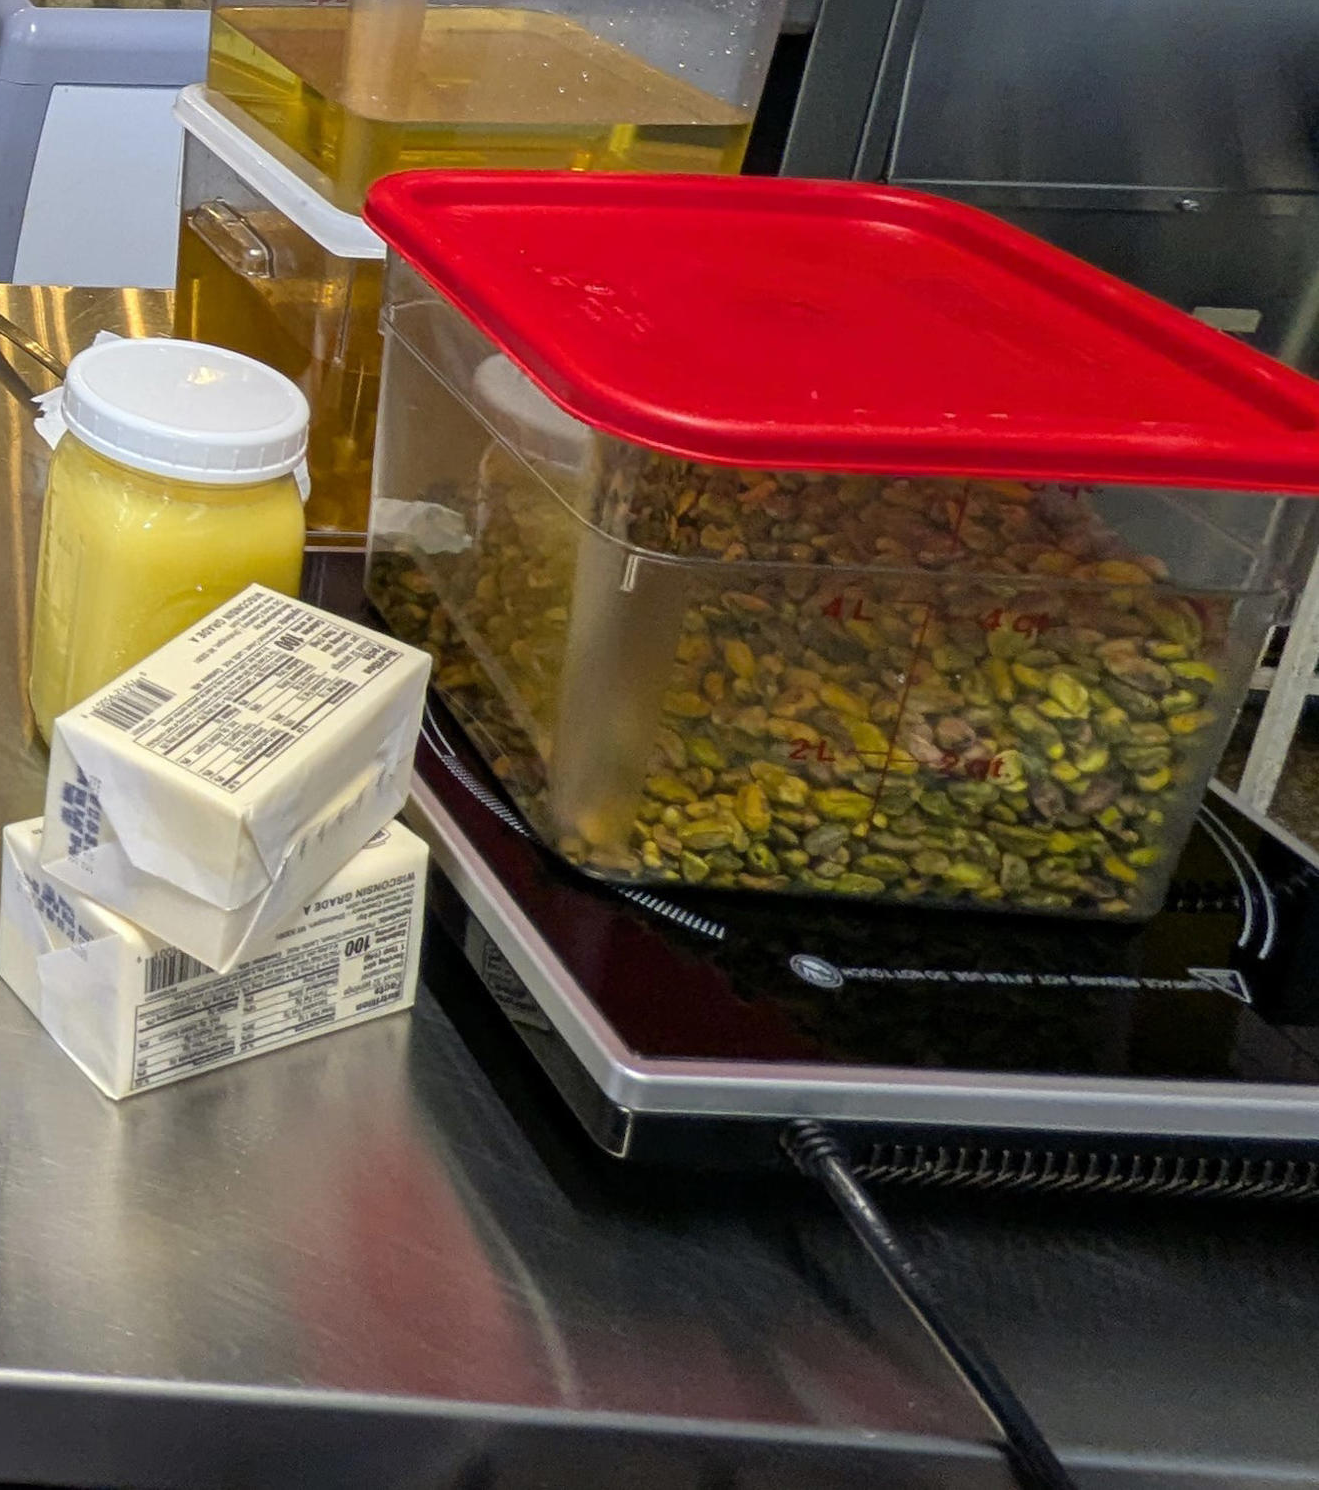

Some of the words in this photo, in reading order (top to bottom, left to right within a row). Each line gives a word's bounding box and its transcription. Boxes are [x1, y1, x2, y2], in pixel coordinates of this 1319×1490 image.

[220, 591, 266, 620] WISCONSIN
[194, 617, 228, 638] GRADE
[187, 636, 202, 644] A
[271, 632, 306, 651] 100
[360, 644, 386, 661] Facts
[361, 649, 398, 675] Nutrition
[355, 870, 415, 899] WISCONSIN
[302, 904, 310, 917] A
[313, 891, 351, 913] GRADE
[344, 933, 371, 957] 100
[373, 979, 401, 996] Facts
[355, 989, 399, 1011] Nutrition
